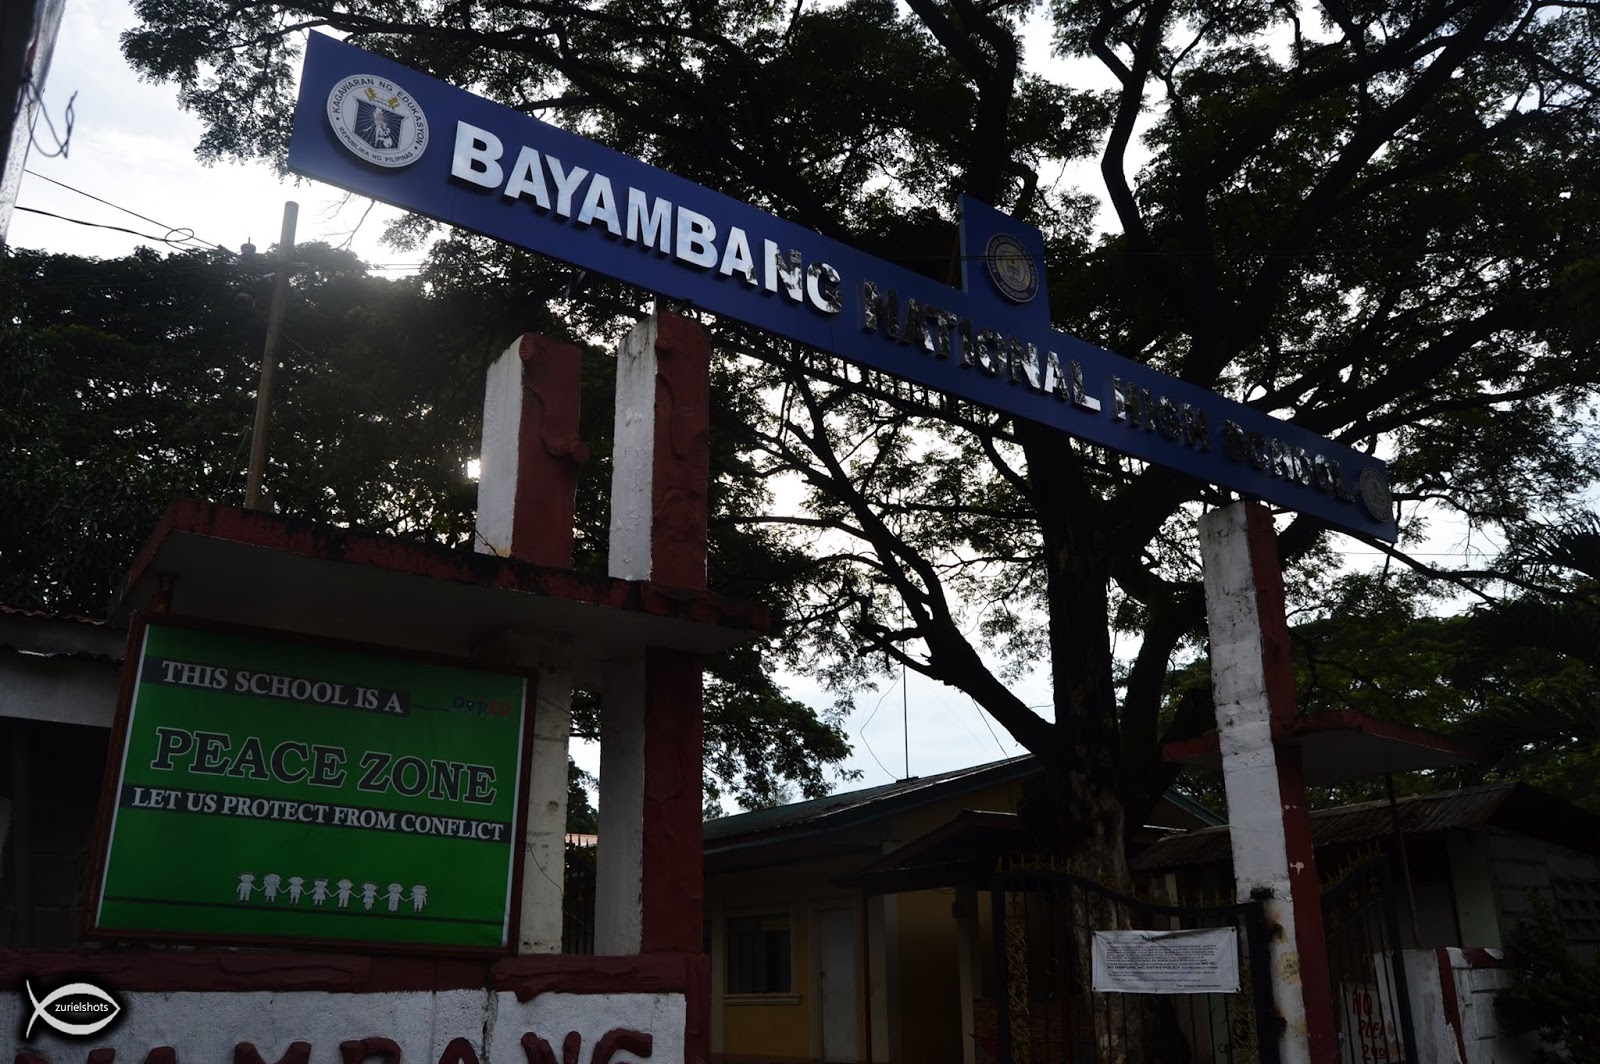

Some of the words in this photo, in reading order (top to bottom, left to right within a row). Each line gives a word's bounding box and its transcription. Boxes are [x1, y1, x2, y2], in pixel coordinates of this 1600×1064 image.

[332, 78, 374, 114] KAGAWARAN
[379, 81, 393, 92] NG
[396, 91, 425, 147] EDUKASYON
[338, 126, 370, 157] REPUBLIKA
[384, 151, 414, 163] PILIPINAS
[451, 119, 842, 315] BAYAMBANG
[861, 278, 1101, 412] NATIONAL
[1112, 375, 1212, 452] HIGH
[1223, 419, 1357, 504] SCHOOL
[161, 659, 229, 691] THIS
[233, 670, 350, 707] SCHOOL
[354, 686, 379, 711] IS
[382, 692, 404, 714] A
[149, 725, 348, 789] PEACE
[357, 750, 497, 807] ZONE
[131, 787, 182, 811] LET
[186, 791, 218, 814] US
[218, 795, 330, 825] PROTECT
[331, 806, 397, 832] FROM
[400, 813, 505, 843] CONFLICT
